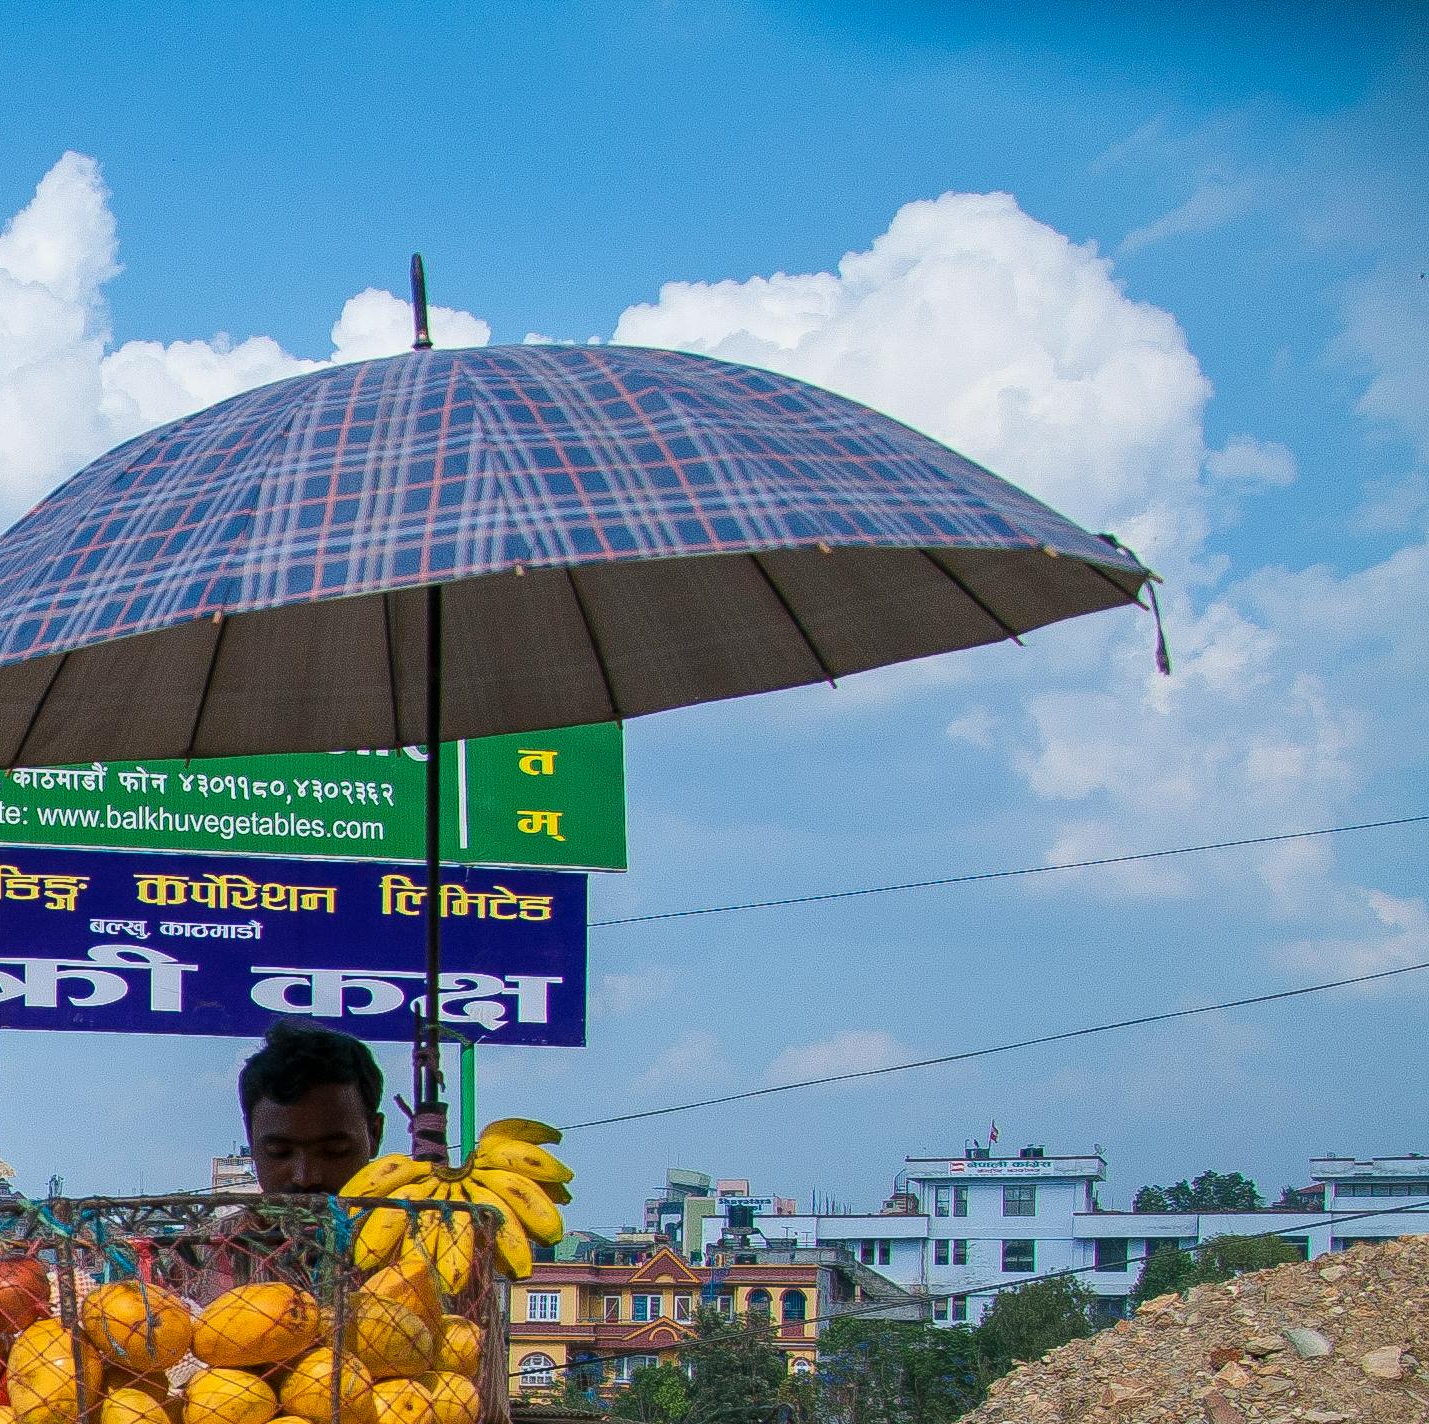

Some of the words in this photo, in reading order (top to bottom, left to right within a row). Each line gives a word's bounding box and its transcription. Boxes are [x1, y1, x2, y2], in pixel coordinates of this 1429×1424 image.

[118, 766, 167, 795] फोन
[37, 803, 385, 840] www.balkhuvegetables.com
[378, 873, 554, 921] लिमिटेड
[250, 965, 564, 1031] कक्ष
